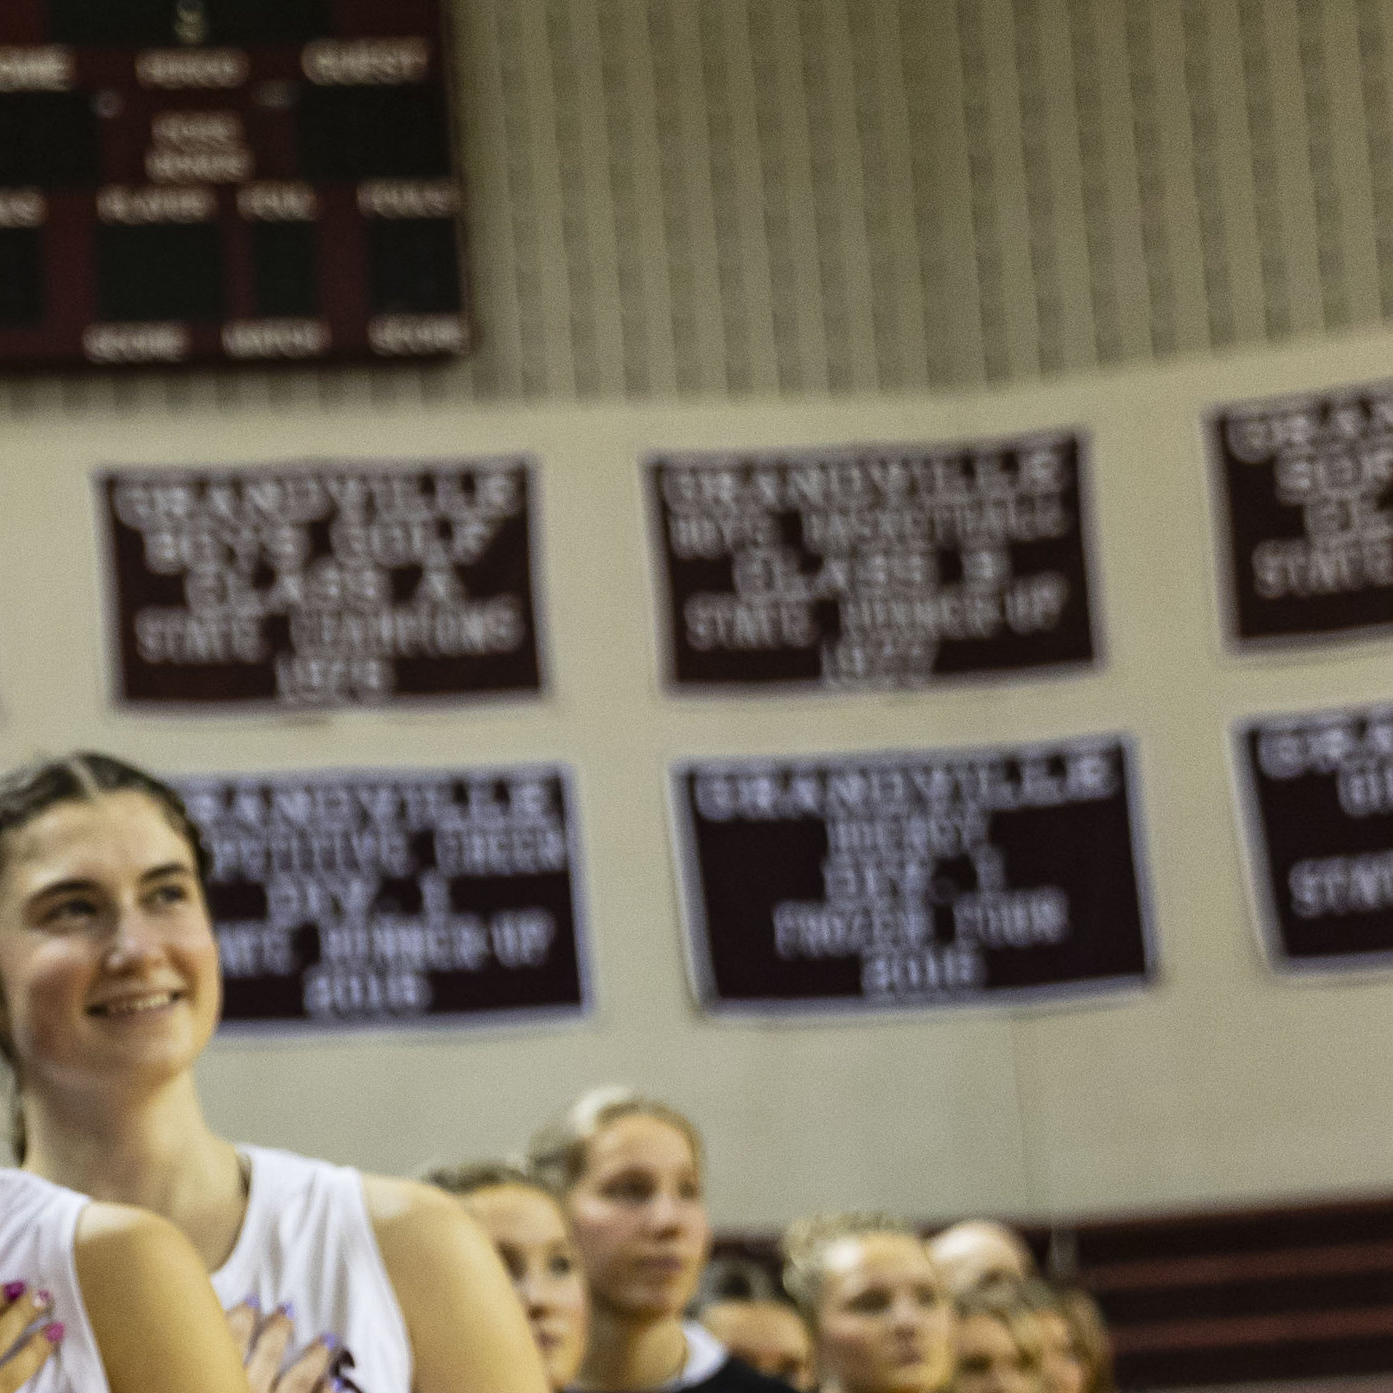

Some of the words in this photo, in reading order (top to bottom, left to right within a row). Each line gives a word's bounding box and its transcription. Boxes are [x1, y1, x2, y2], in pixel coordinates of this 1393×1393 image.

[120, 467, 515, 523] GRANDVILLE
[669, 441, 1064, 507] GRANDVILLE
[701, 748, 1113, 815] GRANDVILLE
